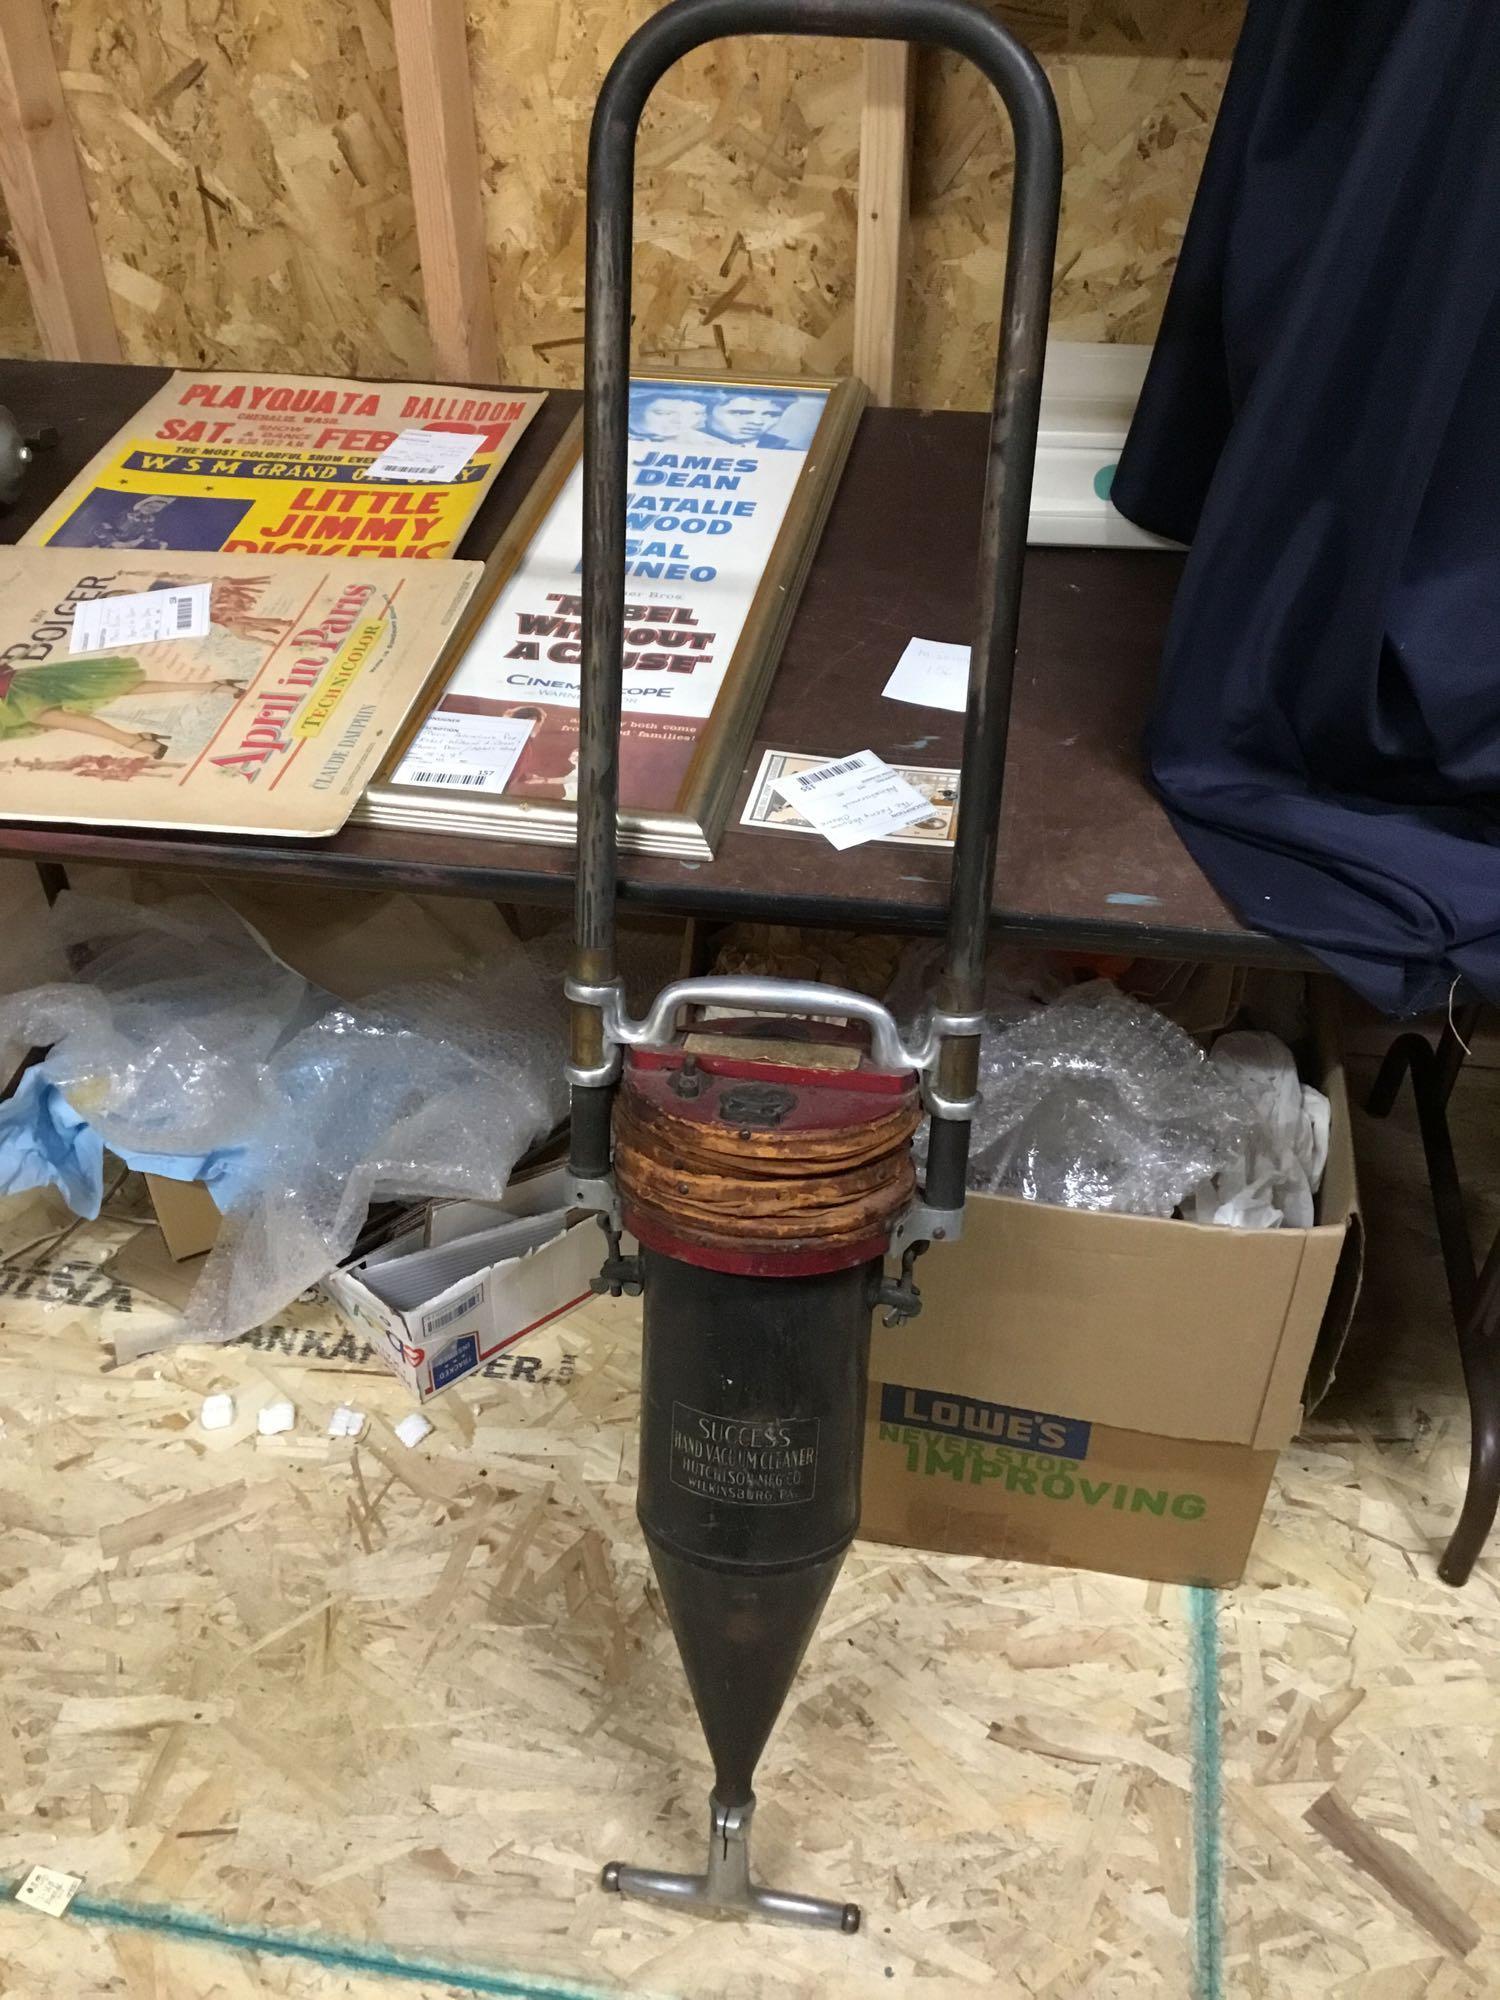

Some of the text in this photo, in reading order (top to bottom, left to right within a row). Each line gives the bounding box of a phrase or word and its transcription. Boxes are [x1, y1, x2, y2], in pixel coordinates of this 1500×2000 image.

[178, 384, 527, 421] PLAYQUATA BALLROOM
[155, 419, 235, 444] SAT.
[176, 446, 197, 455] THE
[202, 448, 235, 457] MOST
[241, 451, 302, 460] COLORFUL
[307, 454, 344, 463] SHOW
[632, 452, 758, 472] JAMES
[253, 463, 337, 479] GRAND
[634, 469, 741, 490] DEAN
[289, 488, 450, 514] LITTLE
[627, 494, 757, 517] ATALIE
[260, 514, 443, 541] JIMMY
[290, 584, 376, 653] Paris
[503, 640, 540, 660] A
[278, 656, 330, 688] in
[302, 624, 381, 729] TECHNICOLOR
[209, 690, 306, 784] April
[630, 721, 658, 729] both
[662, 724, 697, 732] come
[312, 749, 349, 790] CLAUDE
[338, 703, 377, 748] DAUPHIN
[699, 1418, 791, 1449] SUCCESS
[903, 1389, 1067, 1450] LOWE'S
[674, 1430, 814, 1471] HAND VACUUM CLEANER
[878, 1425, 985, 1458] NEVER
[995, 1447, 1081, 1475] STOP
[906, 1443, 1207, 1521] IMPROVING
